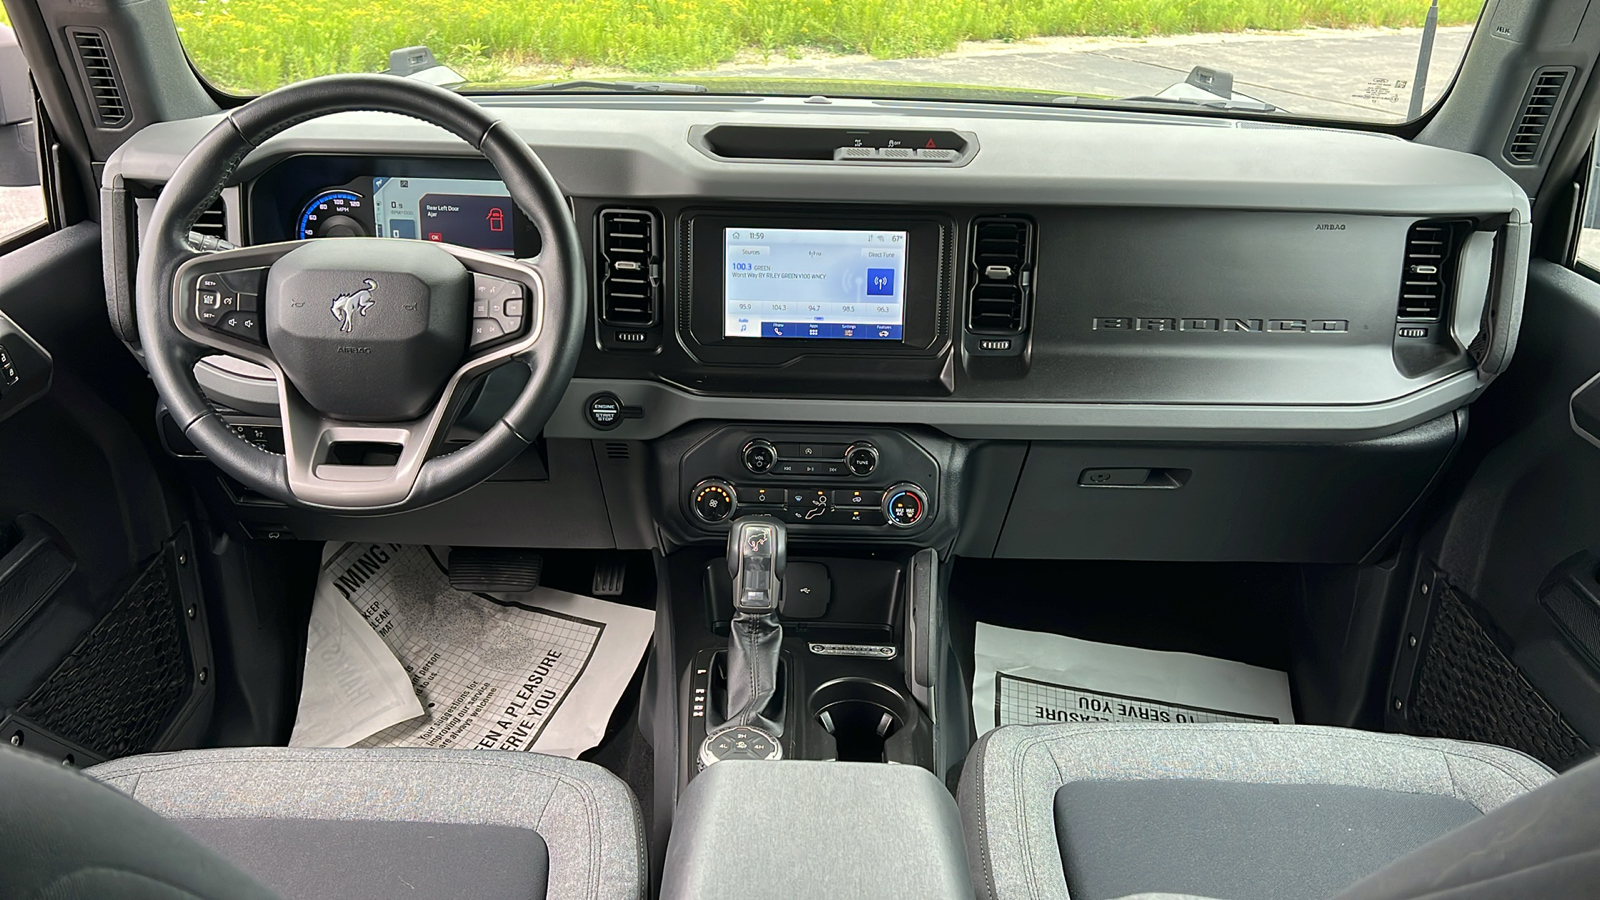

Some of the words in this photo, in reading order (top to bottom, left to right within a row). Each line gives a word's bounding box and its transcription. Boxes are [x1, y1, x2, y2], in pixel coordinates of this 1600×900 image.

[1315, 223, 1346, 231] AIRBAG
[732, 262, 752, 271] 100.3
[1092, 316, 1349, 334] BRONCO
[337, 346, 372, 354] AIRBAG
[361, 601, 380, 620] KEEP
[379, 620, 394, 637] MAT
[419, 652, 441, 676] person
[504, 649, 562, 718] PLEASURE
[418, 724, 436, 740] Your
[434, 690, 471, 727] suggestions
[466, 680, 479, 691] for
[426, 716, 461, 747] improving
[457, 704, 471, 718] our
[470, 682, 491, 706] service
[1079, 696, 1113, 714] YOU
[1117, 703, 1171, 723] SERVE
[449, 717, 474, 740] always
[497, 719, 513, 730] A
[499, 720, 535, 751] ERVE
[527, 689, 557, 717] YOU
